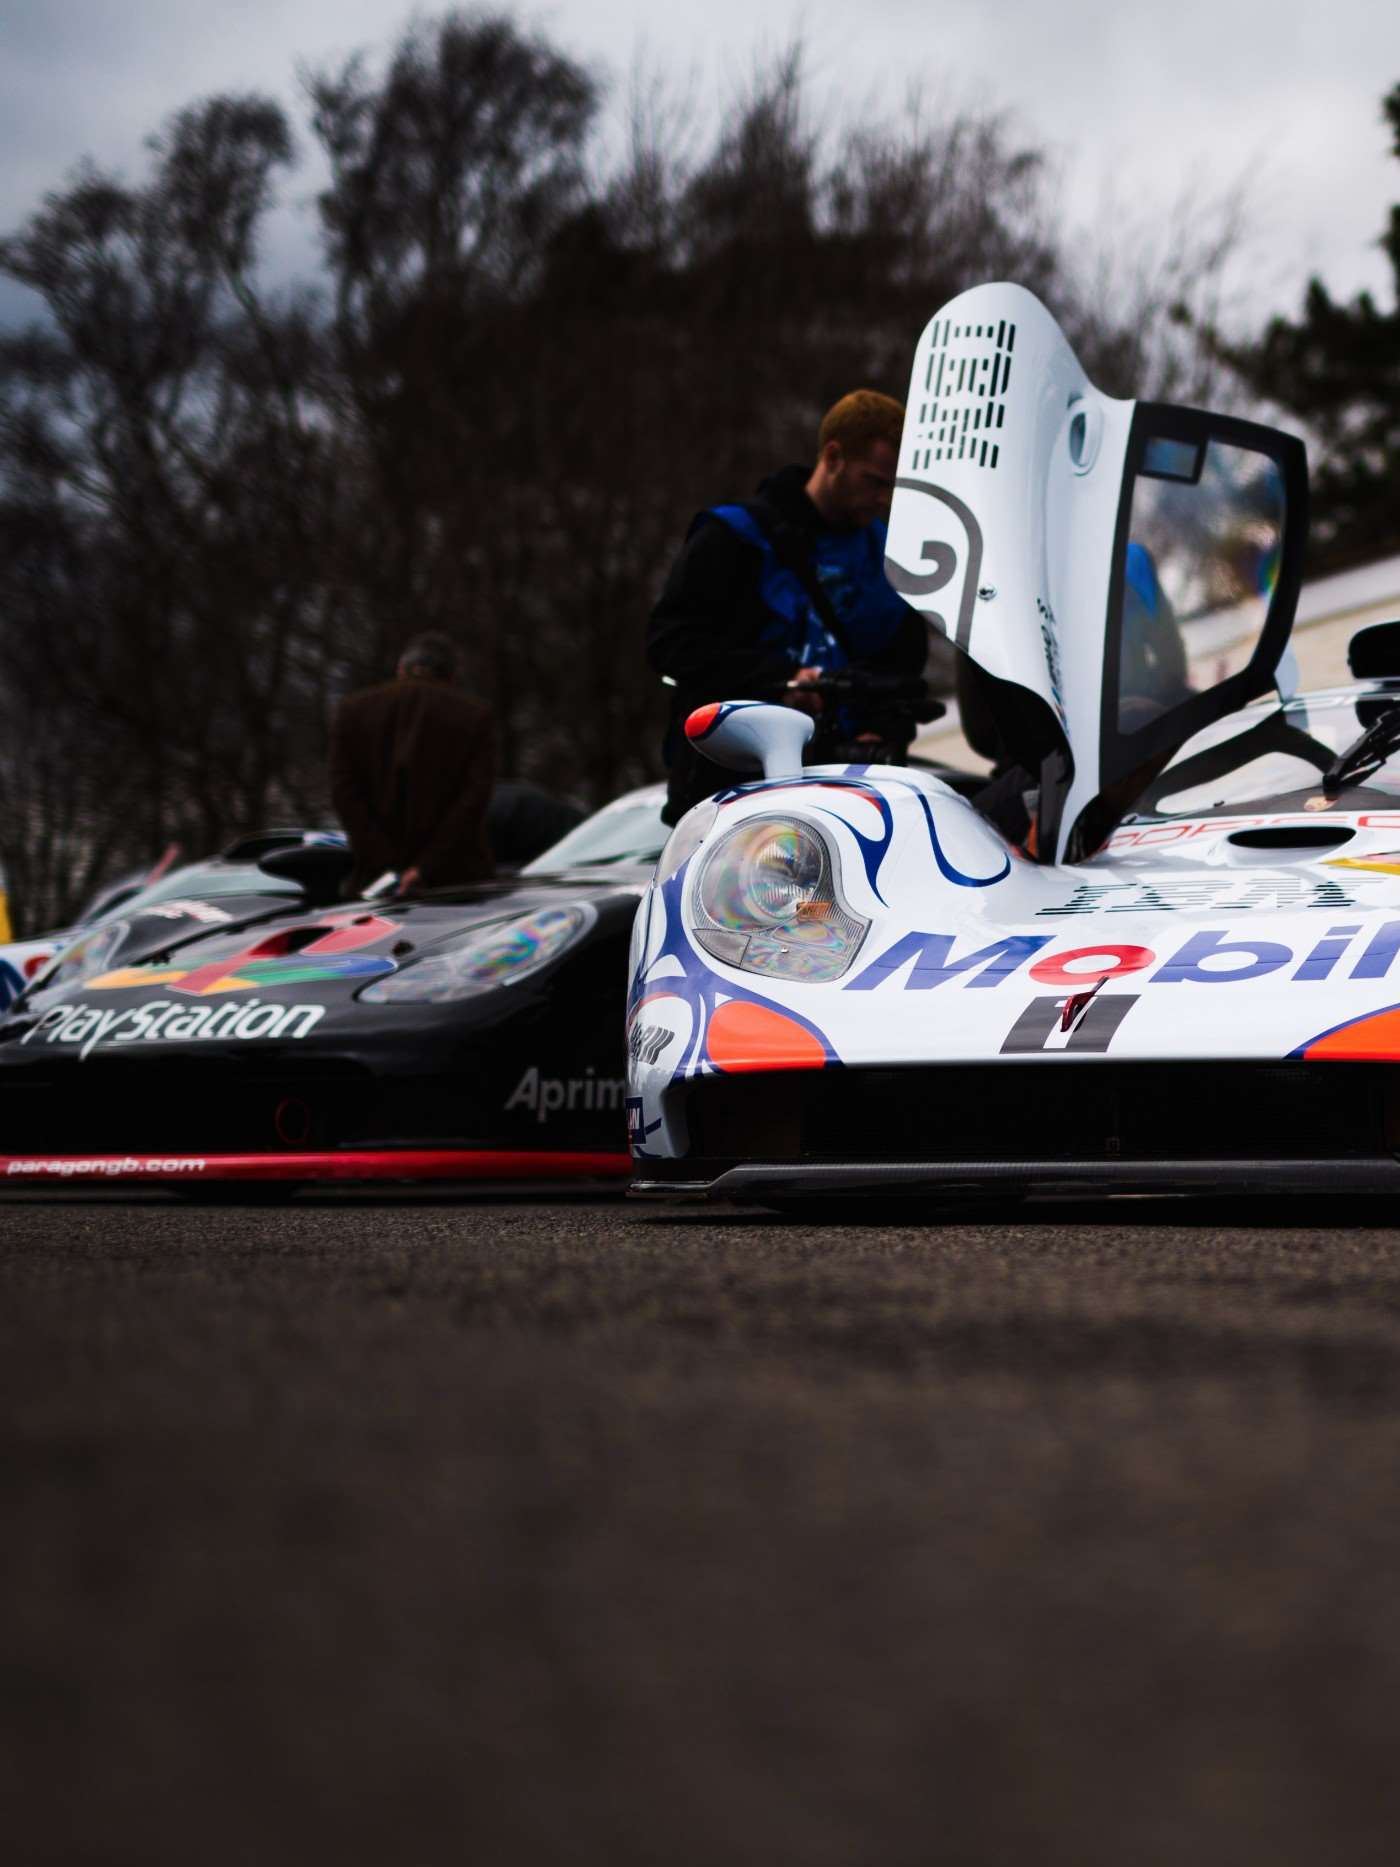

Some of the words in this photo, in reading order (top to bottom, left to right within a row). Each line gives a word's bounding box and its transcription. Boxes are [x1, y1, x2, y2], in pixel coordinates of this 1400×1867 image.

[912, 320, 1016, 471] IBM
[20, 998, 326, 1061] PlayStation
[7, 1157, 207, 1176] paragongb.com
